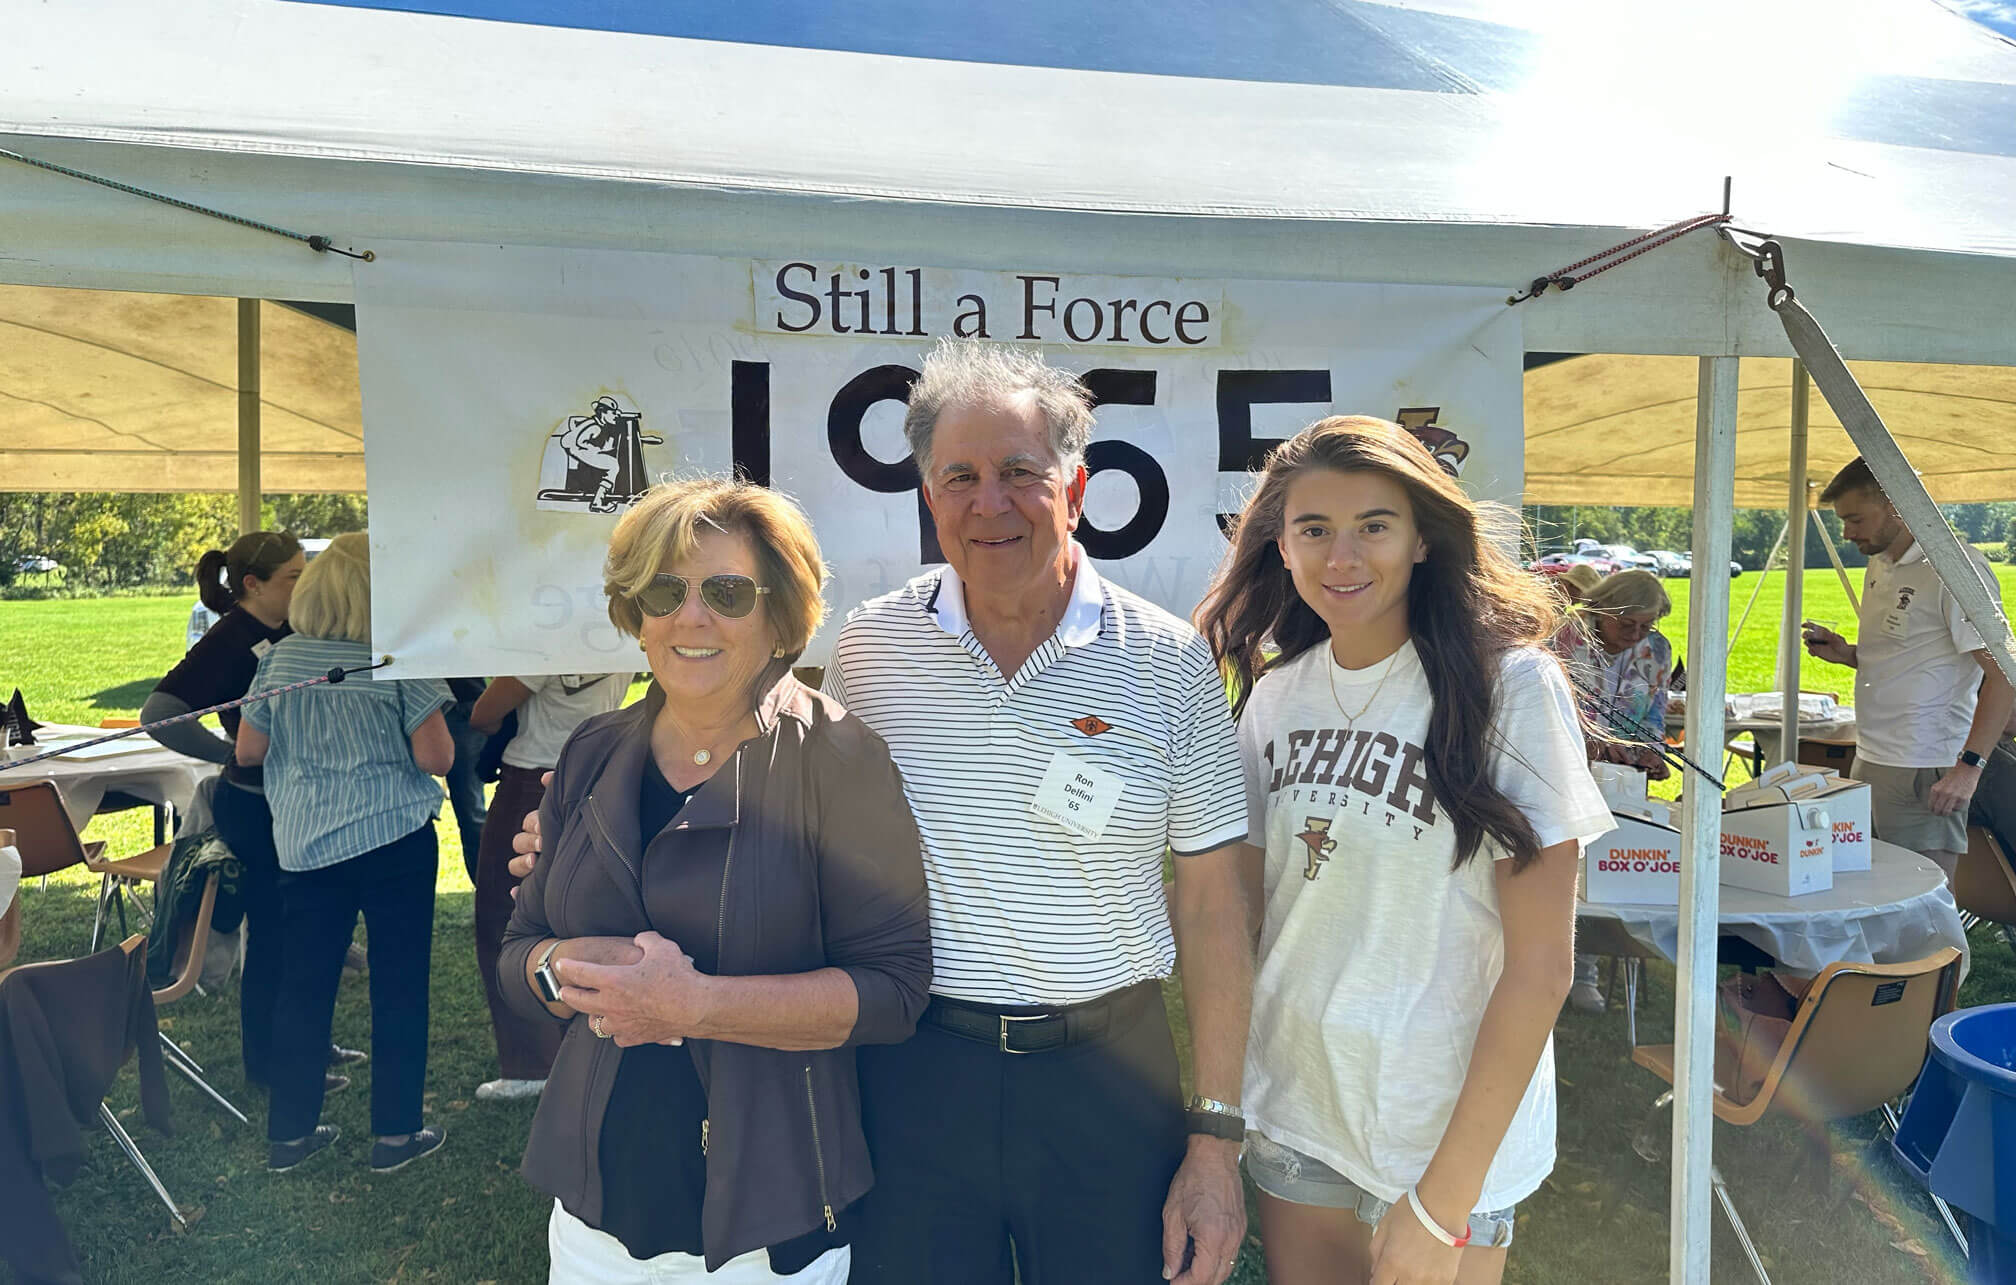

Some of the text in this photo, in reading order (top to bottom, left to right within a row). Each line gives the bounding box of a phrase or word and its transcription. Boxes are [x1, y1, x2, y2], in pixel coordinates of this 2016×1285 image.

[776, 263, 1210, 345] Still a Force
[1075, 773, 1094, 788] Ron
[1264, 729, 1436, 826] LEHIGH
[1064, 783, 1095, 803] Delfini
[1067, 798, 1080, 811] '65
[1609, 848, 1671, 860] DUNKIN'
[1720, 844, 1735, 857] OX
[1598, 860, 1631, 872] BOX
